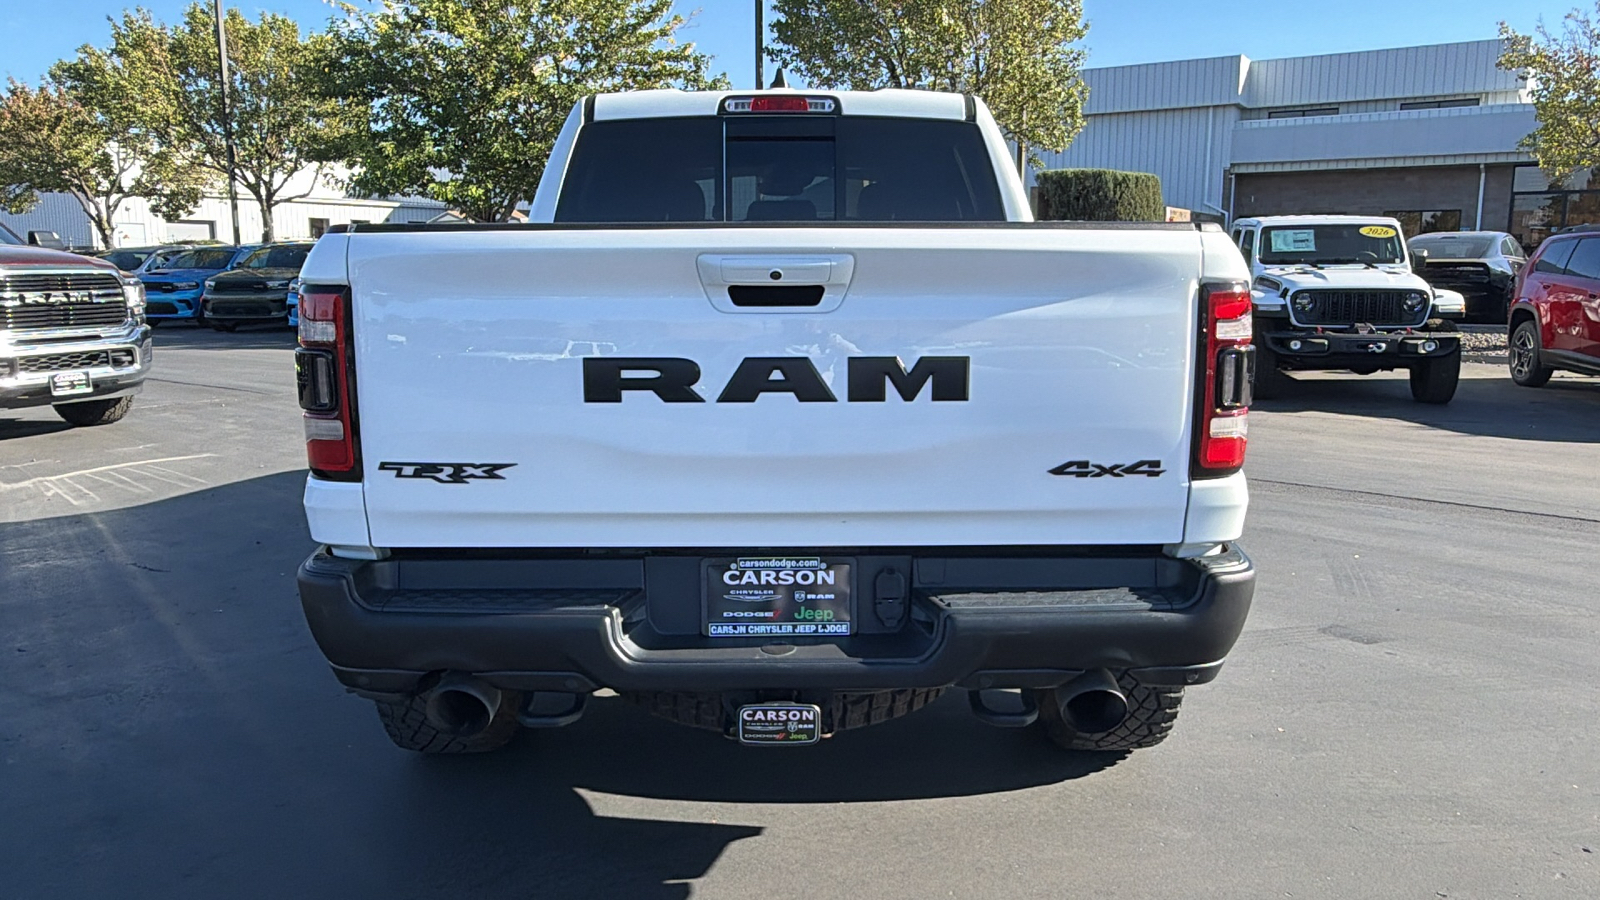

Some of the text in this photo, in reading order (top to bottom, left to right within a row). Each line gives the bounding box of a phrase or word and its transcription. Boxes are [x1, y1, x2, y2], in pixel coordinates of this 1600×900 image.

[1365, 227, 1390, 236] 2026
[583, 356, 970, 403] RAM
[378, 461, 518, 484] TRX
[1046, 459, 1167, 478] 4x4
[739, 558, 818, 569] carsondodge.com
[722, 570, 835, 585] CARSON
[794, 606, 834, 622] Jeep
[748, 625, 793, 634] CHRYSLER
[794, 624, 816, 633] JEEP
[742, 710, 814, 721] CARSON
[789, 732, 807, 740] Jeep
